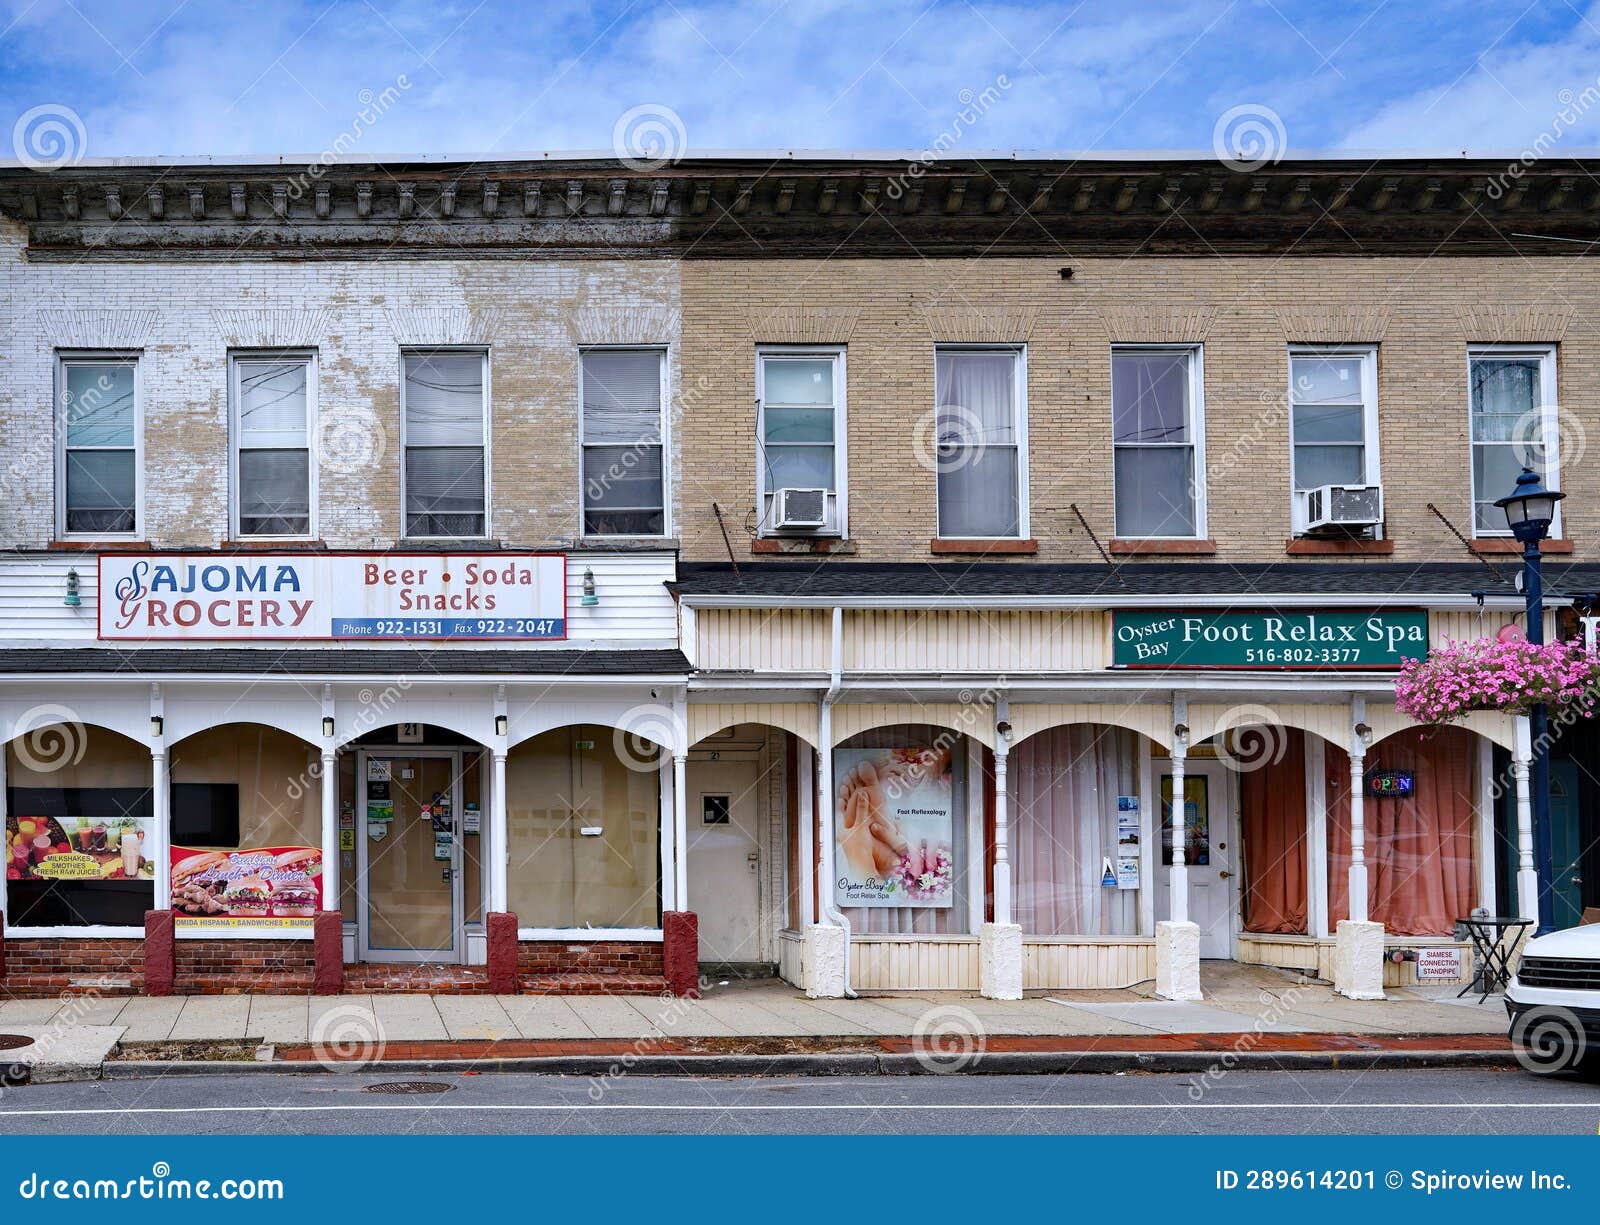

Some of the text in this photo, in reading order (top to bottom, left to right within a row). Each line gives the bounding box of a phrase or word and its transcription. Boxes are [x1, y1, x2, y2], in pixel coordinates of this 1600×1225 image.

[115, 560, 301, 601] SAJOMA
[364, 562, 533, 586] Beer Soda
[115, 585, 314, 630] GROCERY
[399, 587, 497, 611] Snacks
[342, 620, 555, 635] Phone 922-1531 Fax 922-2047
[1117, 615, 1425, 653] Oyster Foot Relax Spa
[1135, 640, 1170, 660] Bay
[1246, 648, 1361, 663] 516-802-3377
[404, 722, 418, 736] 21
[1372, 778, 1411, 791] OPEN
[1419, 959, 1460, 967] CONNECTION
